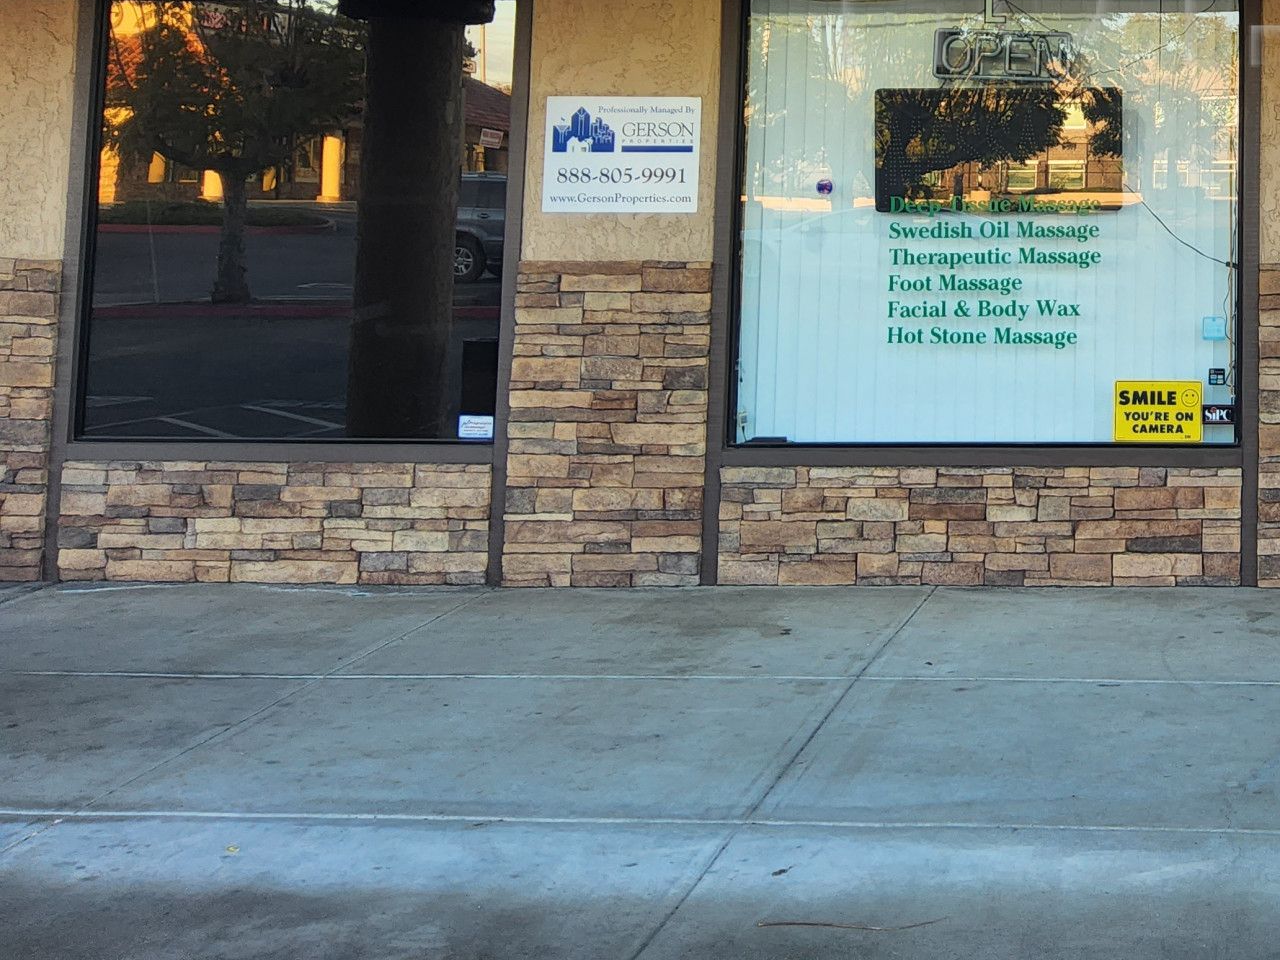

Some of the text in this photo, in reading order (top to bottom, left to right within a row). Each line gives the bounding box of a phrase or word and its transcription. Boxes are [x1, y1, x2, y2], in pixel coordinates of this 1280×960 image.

[942, 35, 1072, 79] OPEN
[598, 106, 695, 115] Professionally Managed By
[622, 122, 694, 137] GERSON
[556, 167, 686, 184] 888-805-9991
[549, 193, 691, 205] www.GersonProperties.com
[890, 195, 1101, 217] Deep Tissue Massage
[889, 221, 1100, 242] Swedish Oil Massage
[889, 247, 1101, 269] Therapeutic Massage
[888, 274, 1023, 295] Foot Massage
[887, 299, 1080, 321] Facial & Body Wax
[887, 327, 1078, 349] Hot Stone Massage
[1118, 390, 1177, 406] SMILE
[1124, 411, 1194, 422] YOU'RE ON
[1132, 424, 1184, 434] CAMERA
